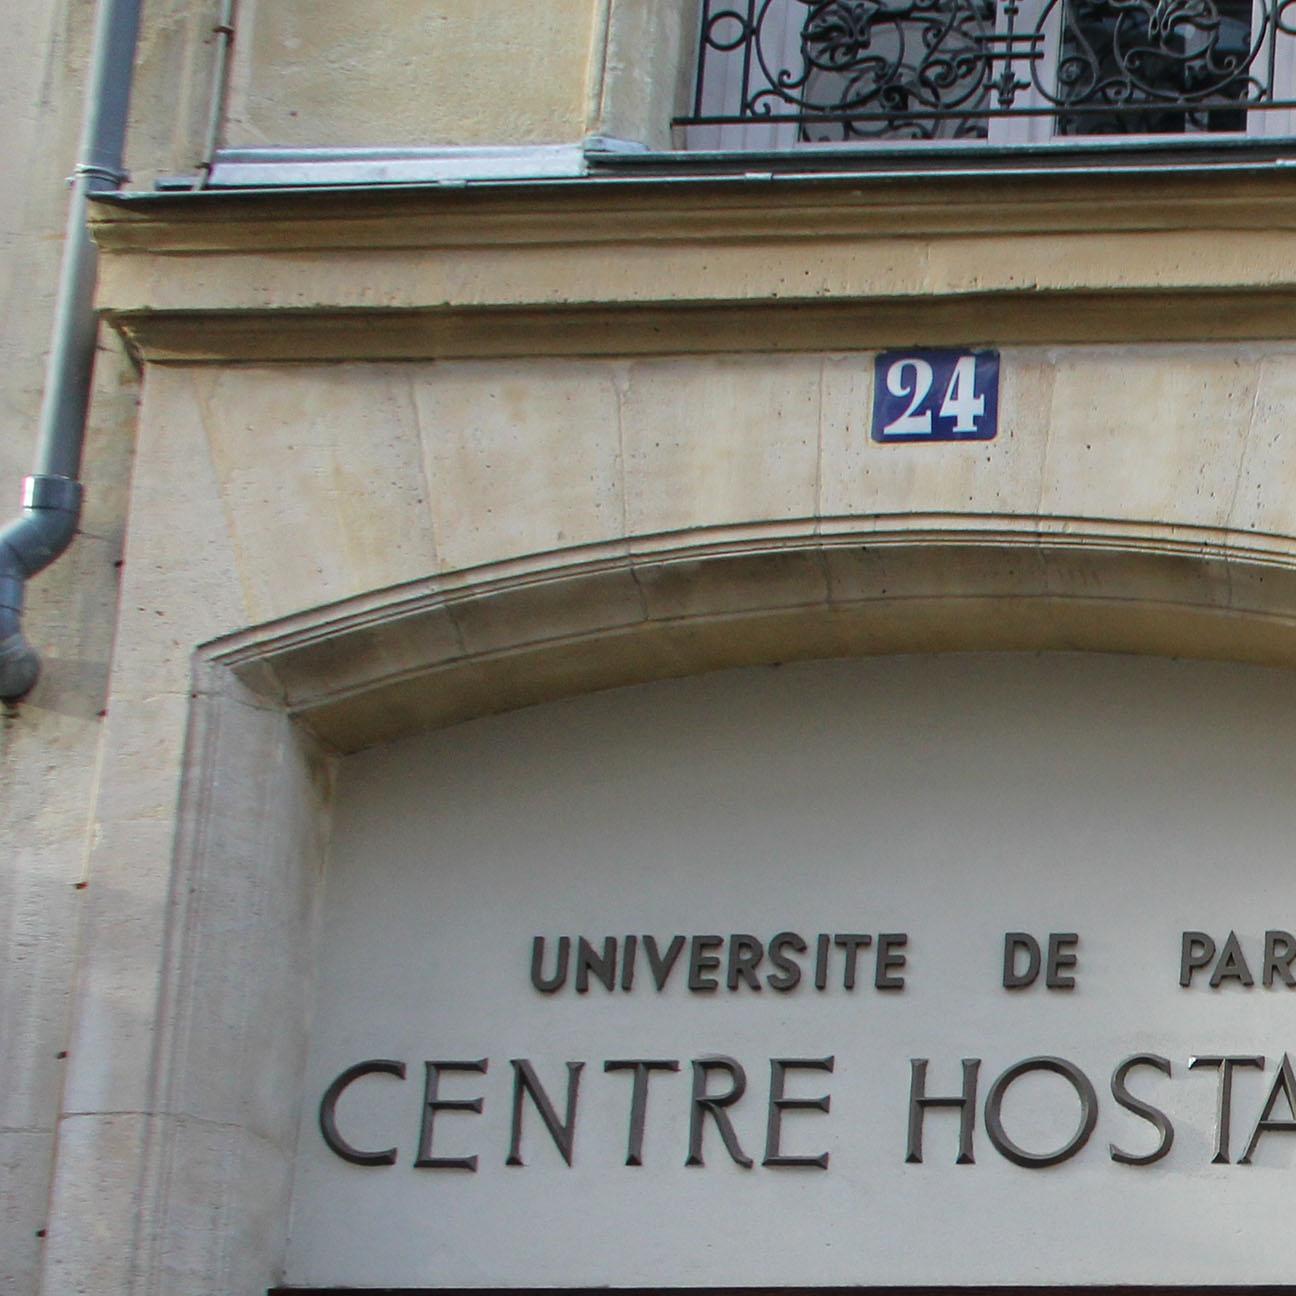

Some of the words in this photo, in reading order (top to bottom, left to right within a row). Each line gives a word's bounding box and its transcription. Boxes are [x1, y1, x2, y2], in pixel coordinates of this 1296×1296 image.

[883, 355, 985, 435] 24
[531, 934, 909, 993] UNIVERSITE
[1003, 934, 1079, 990] DE
[320, 1055, 836, 1171] CENTRE
